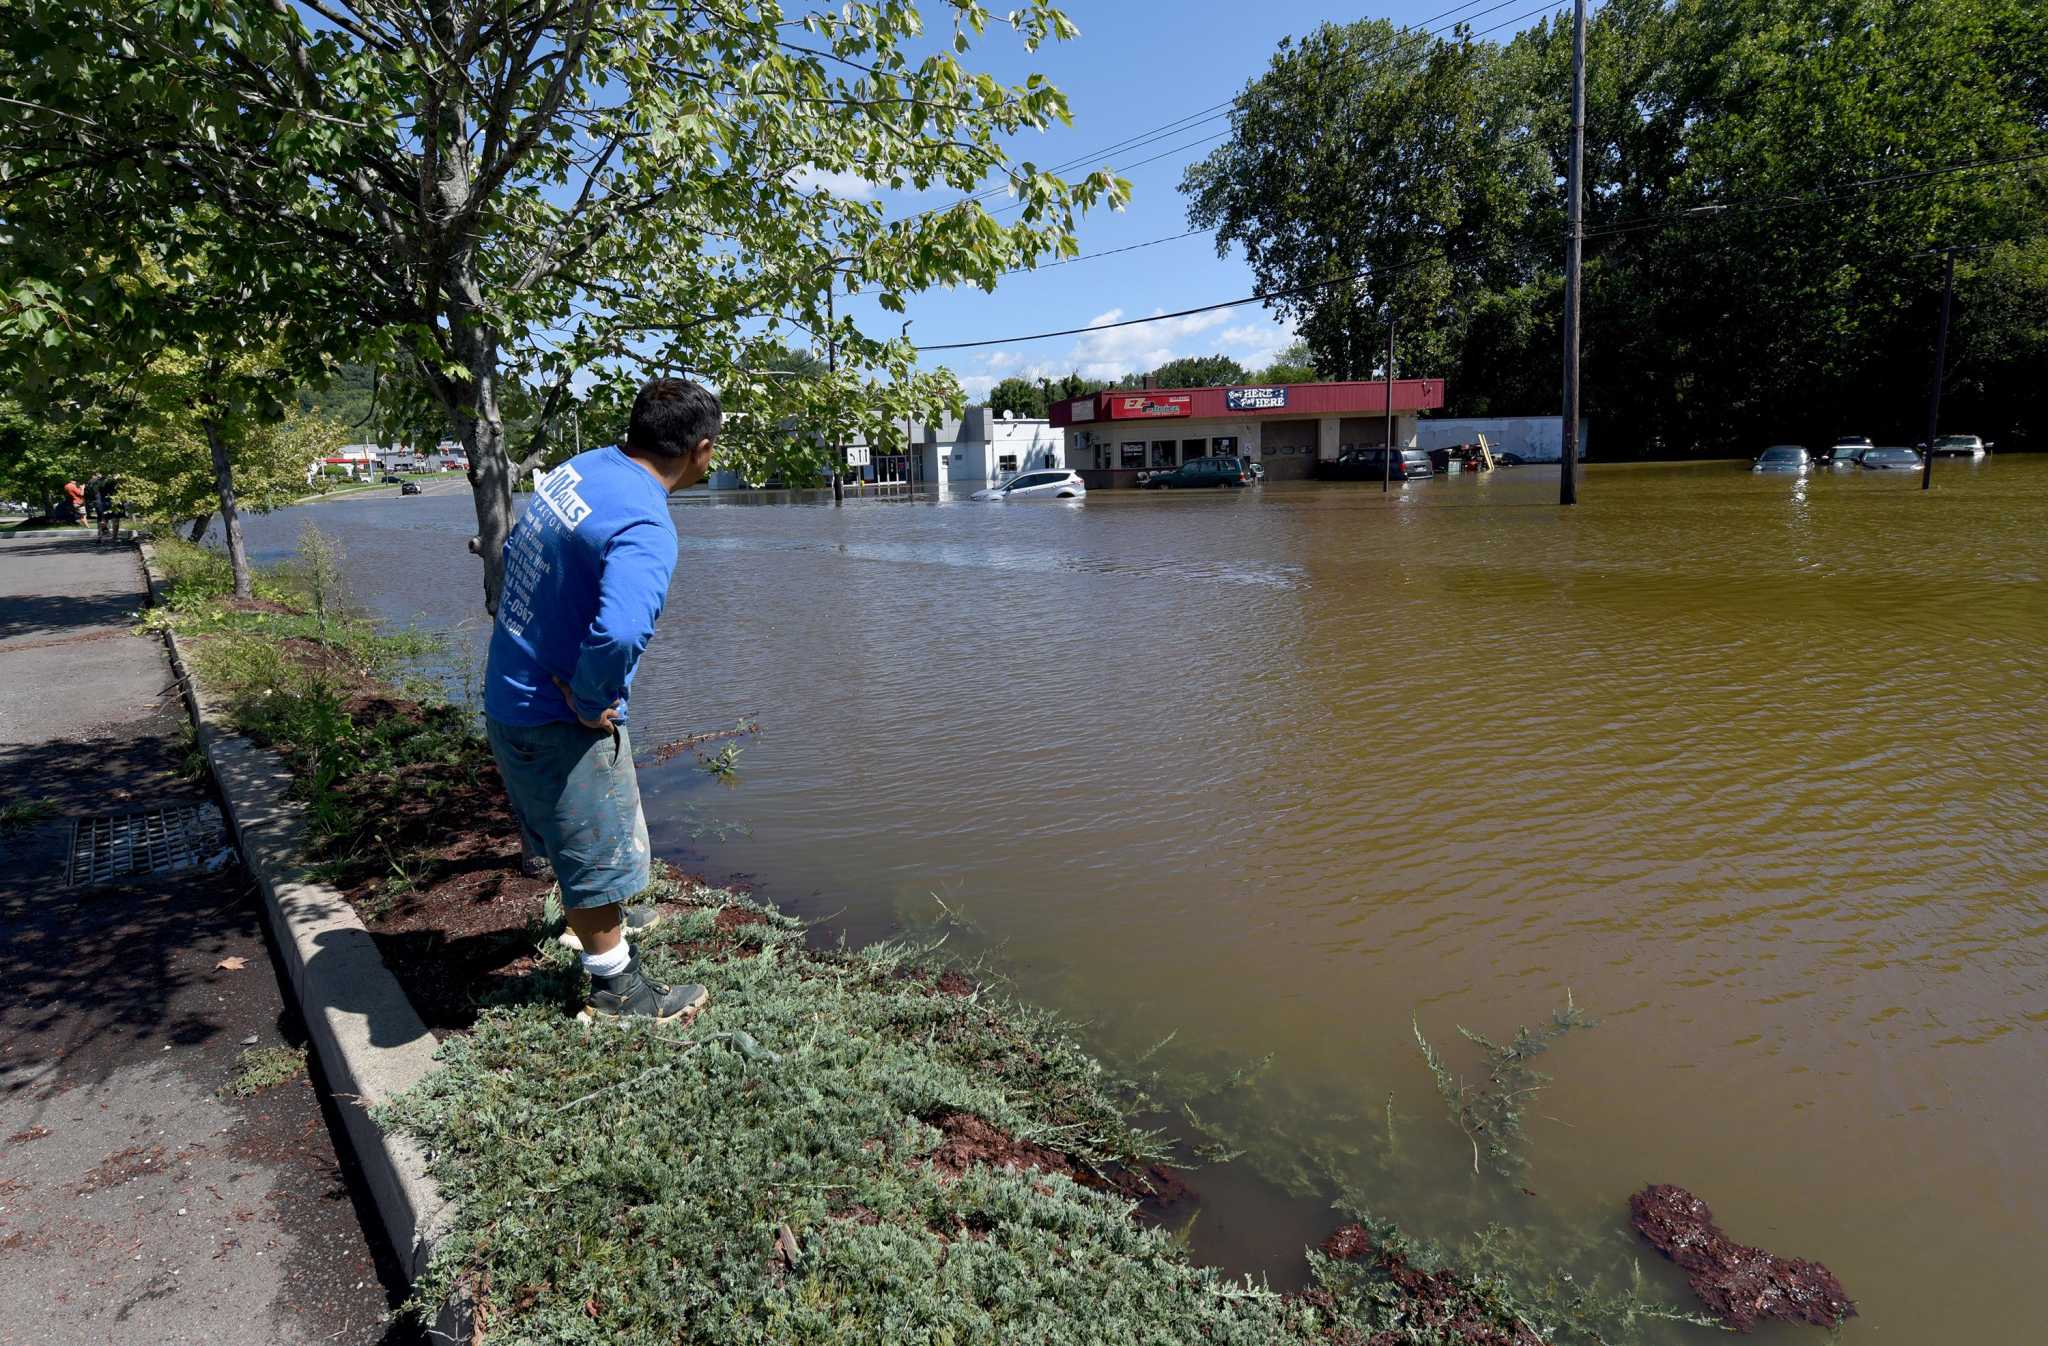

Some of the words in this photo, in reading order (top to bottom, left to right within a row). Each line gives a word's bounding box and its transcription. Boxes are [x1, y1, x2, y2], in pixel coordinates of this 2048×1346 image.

[1244, 388, 1273, 398] HERE
[1124, 398, 1146, 410] EZ
[1256, 397, 1285, 407] HERE
[533, 552, 551, 574] Work
